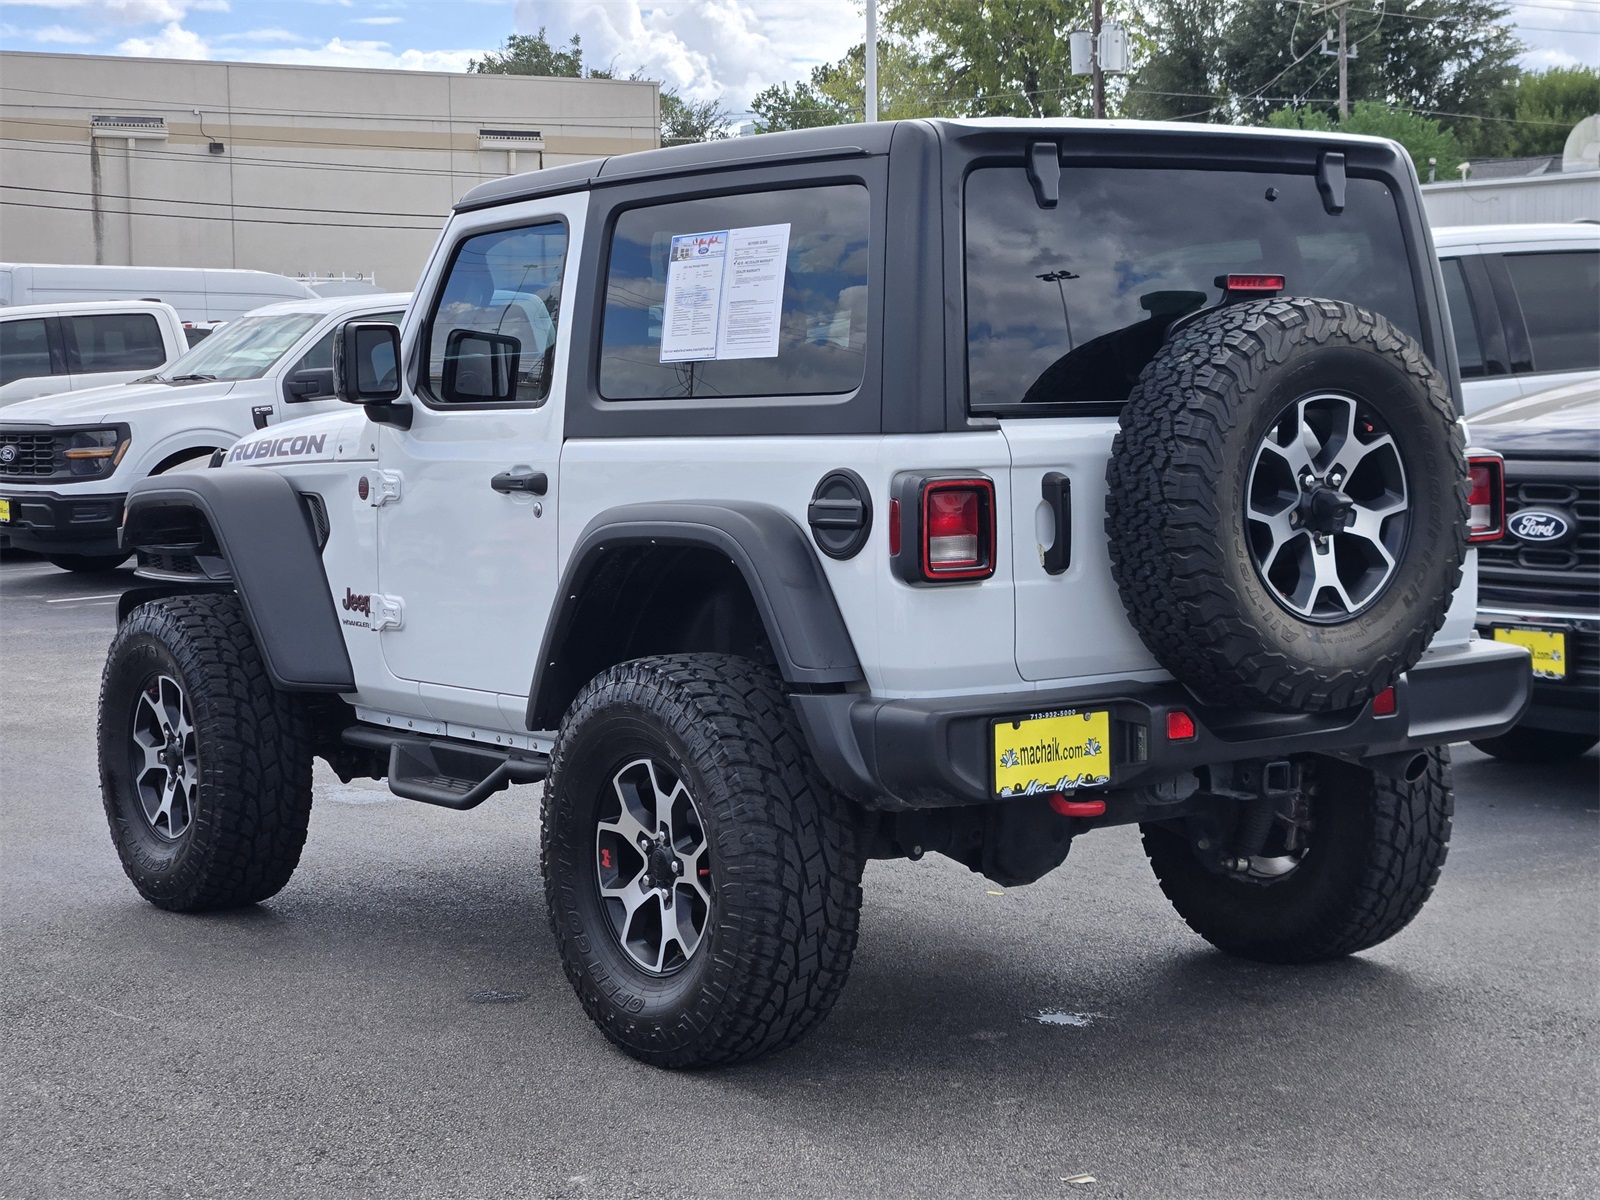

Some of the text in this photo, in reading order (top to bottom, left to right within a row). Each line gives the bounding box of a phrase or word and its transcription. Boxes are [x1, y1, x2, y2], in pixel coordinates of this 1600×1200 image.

[228, 433, 327, 462] RUBICON
[1518, 515, 1556, 537] Ford
[342, 586, 371, 618] Jeep
[342, 618, 370, 629] WRANGLER
[1029, 709, 1076, 720] 713-932-5000
[1019, 737, 1083, 766] machaik.com
[1025, 779, 1053, 796] Mac
[1055, 773, 1086, 792] Haik
[588, 961, 646, 1013] OPEN
